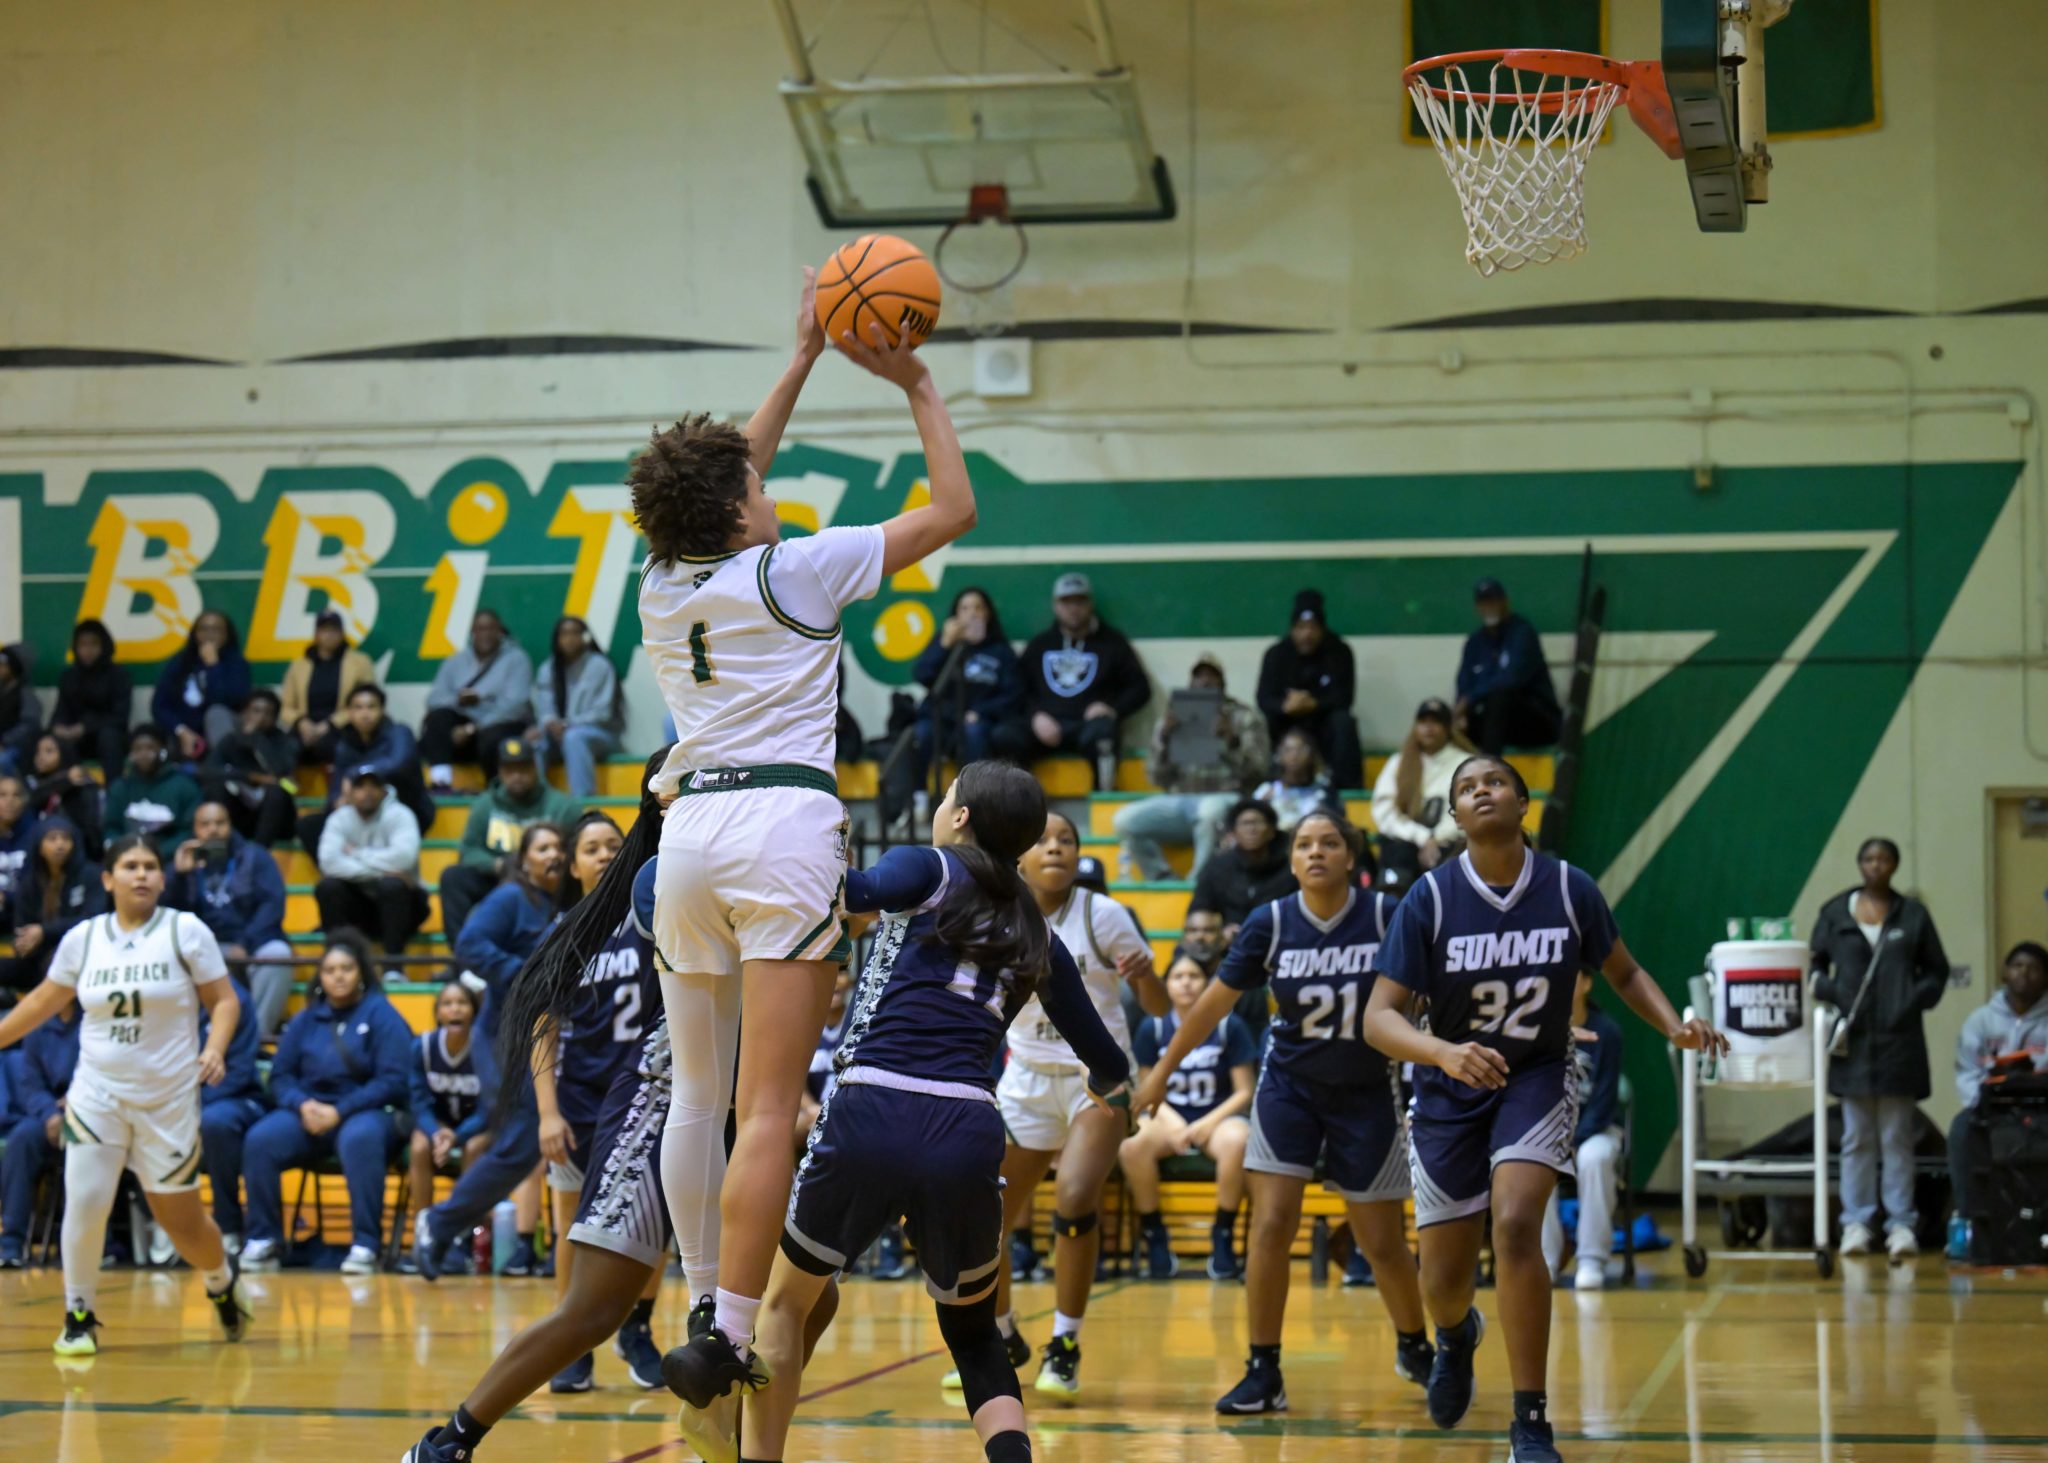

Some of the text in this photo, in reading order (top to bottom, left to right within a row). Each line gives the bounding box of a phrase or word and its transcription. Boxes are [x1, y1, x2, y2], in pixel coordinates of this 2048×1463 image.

[687, 618, 720, 689] 1
[1276, 942, 1381, 980] SUMMIT
[1445, 926, 1570, 974] SUMMIT
[86, 963, 171, 988] LONG BEACH
[107, 989, 143, 1019] 21
[1297, 980, 1360, 1041] 21
[1469, 975, 1551, 1041] 32
[1729, 983, 1798, 1008] MUSCLE
[1741, 1005, 1788, 1029] MILK
[1165, 1069, 1217, 1108] 20
